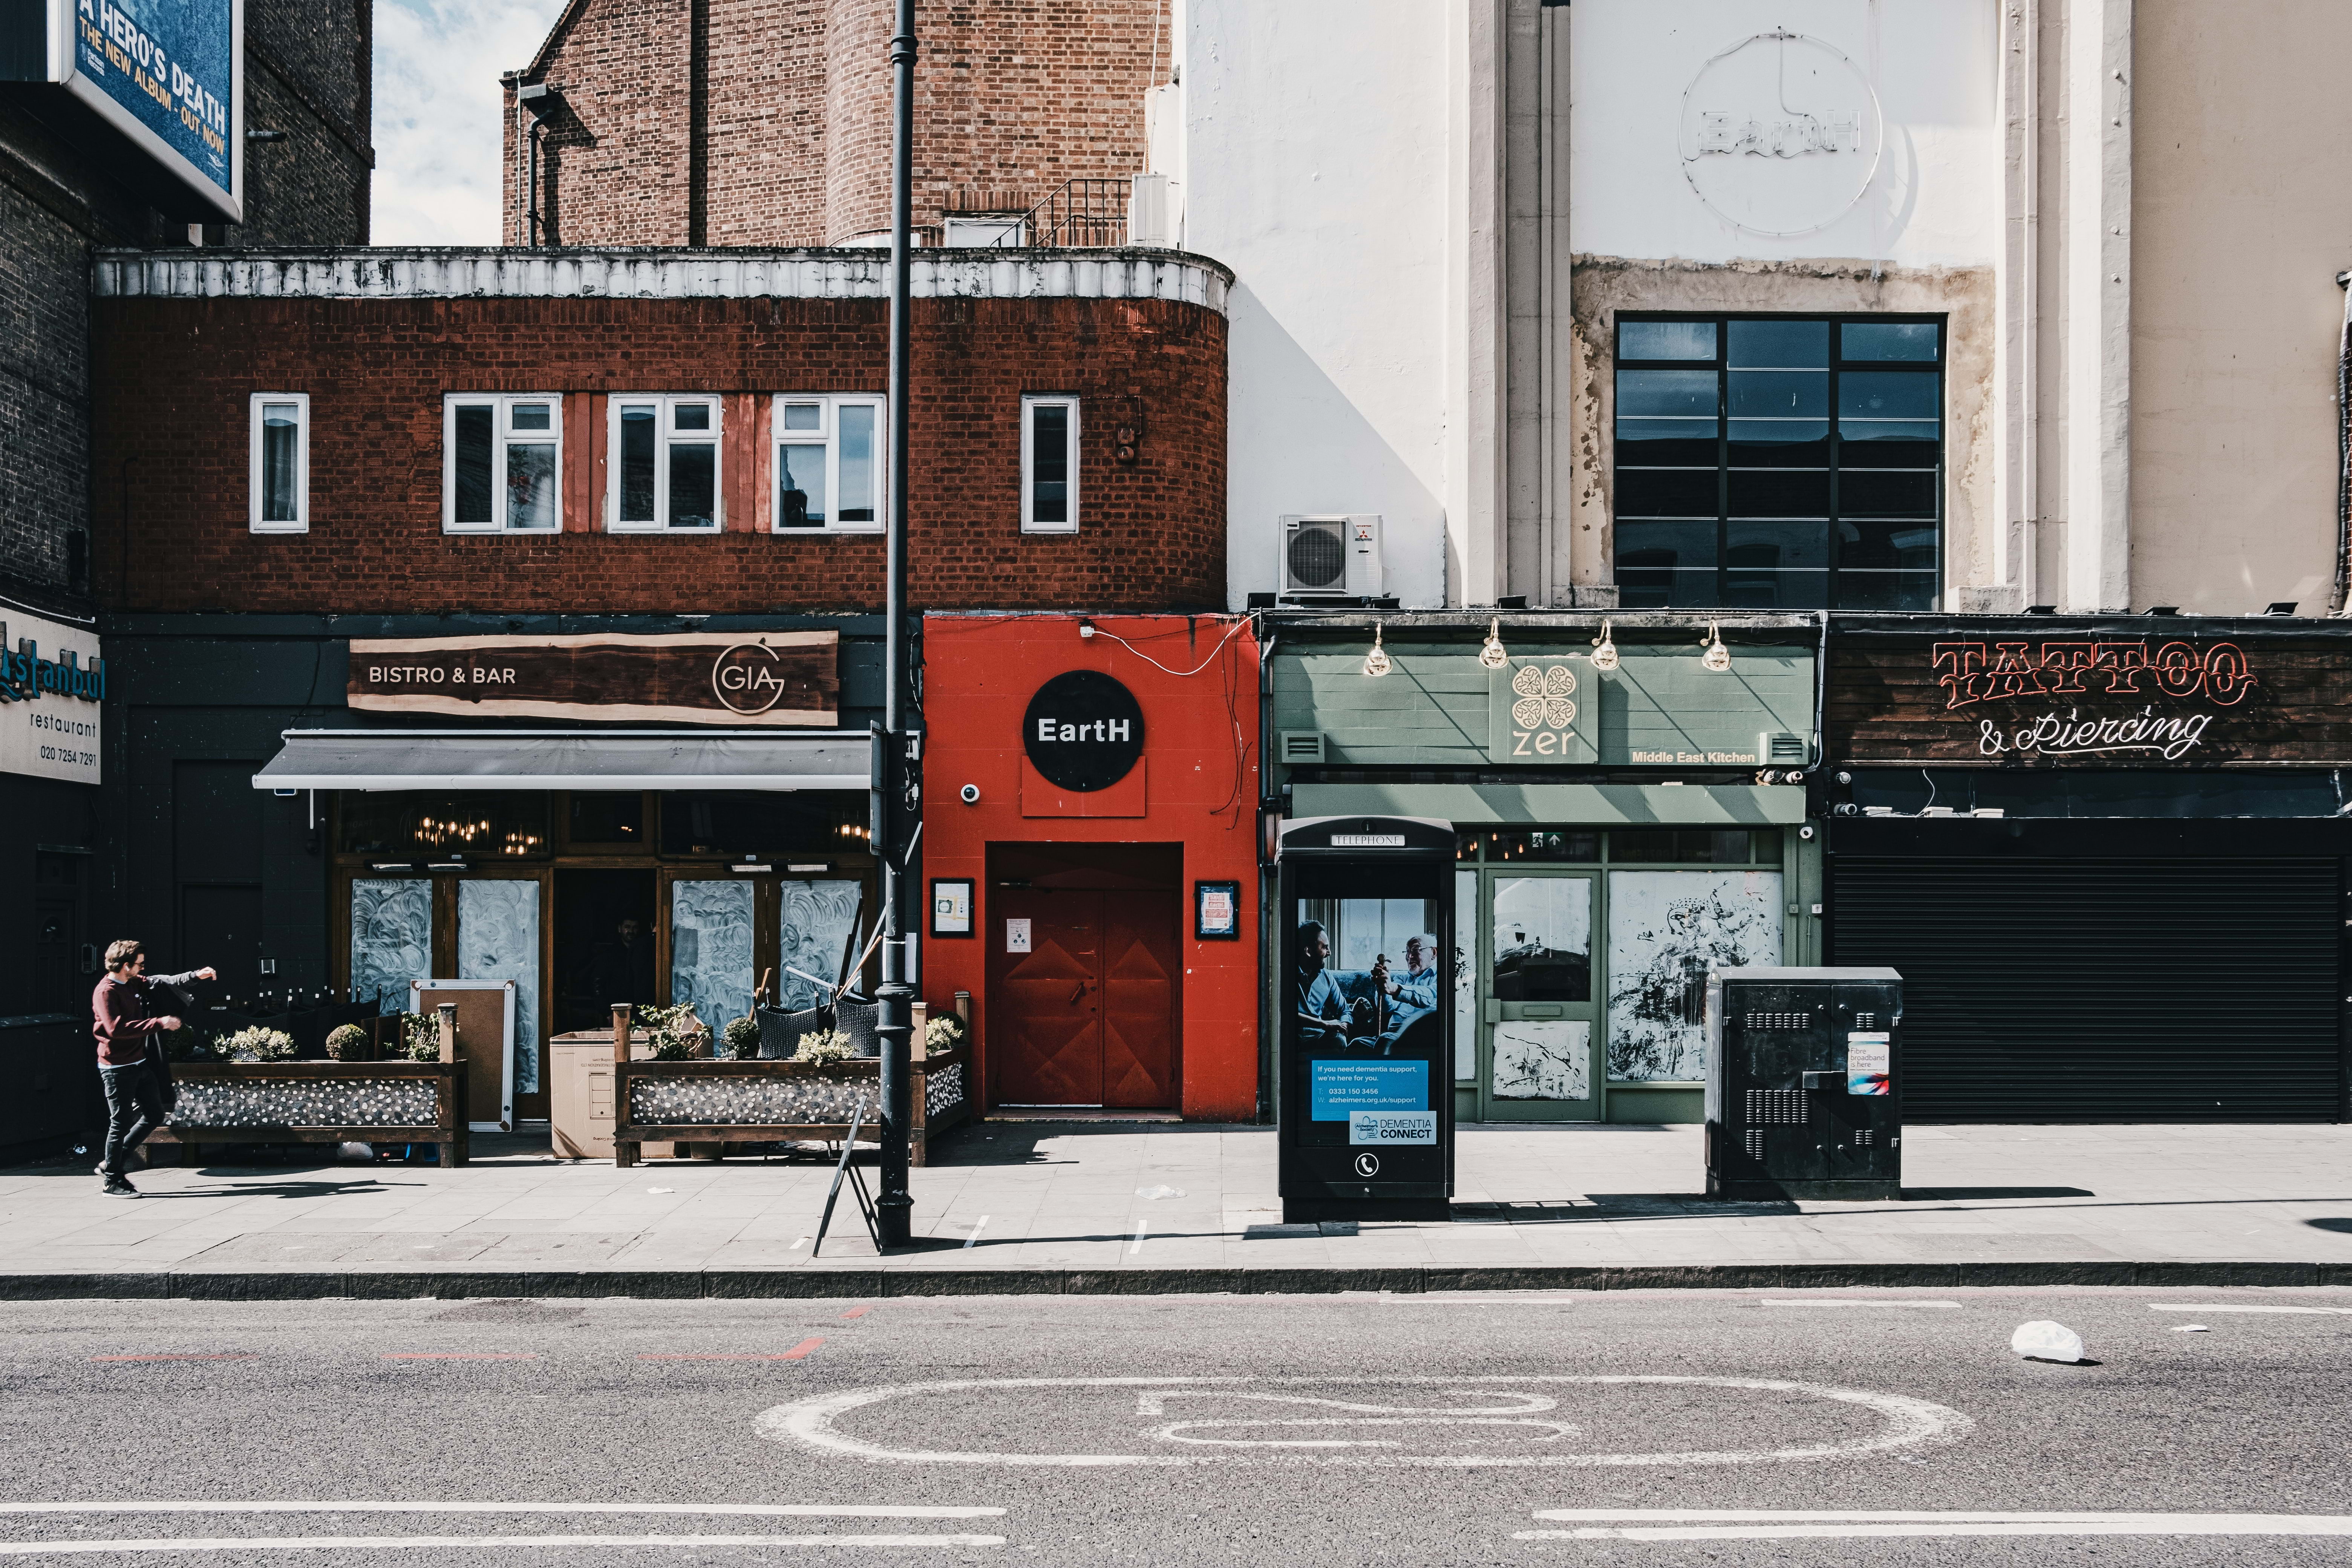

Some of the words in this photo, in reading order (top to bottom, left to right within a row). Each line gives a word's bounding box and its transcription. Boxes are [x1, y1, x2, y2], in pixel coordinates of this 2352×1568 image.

[80, 0, 94, 21] A
[101, 0, 166, 82] HERO'S
[172, 62, 225, 135] DEATH
[80, 15, 102, 52] THE
[106, 39, 131, 75] NEW
[135, 66, 171, 112] ALBUM
[181, 106, 200, 134] OUT
[203, 124, 224, 155] NOW
[1698, 109, 1860, 152] EartH
[369, 667, 445, 683] BISTRO
[452, 668, 466, 683] &
[473, 668, 516, 683] BAR
[721, 666, 776, 689] GIA
[1933, 642, 2259, 709] TATTOO
[31, 714, 96, 738] restaurant
[1038, 718, 1130, 742] EartH
[1979, 719, 2010, 755] &
[2015, 705, 2213, 760] Piercing
[1512, 730, 1575, 755] zer
[41, 746, 55, 761] 020
[58, 748, 77, 764] 7254
[80, 752, 96, 767] 7291
[1632, 752, 1674, 763] Middle
[1677, 752, 1705, 763] East
[1708, 752, 1755, 763] Kitchen
[1336, 836, 1400, 845] TELEPHONE
[1380, 1119, 1432, 1128] DEMENTIA
[1380, 1129, 1432, 1138] CONNECT
